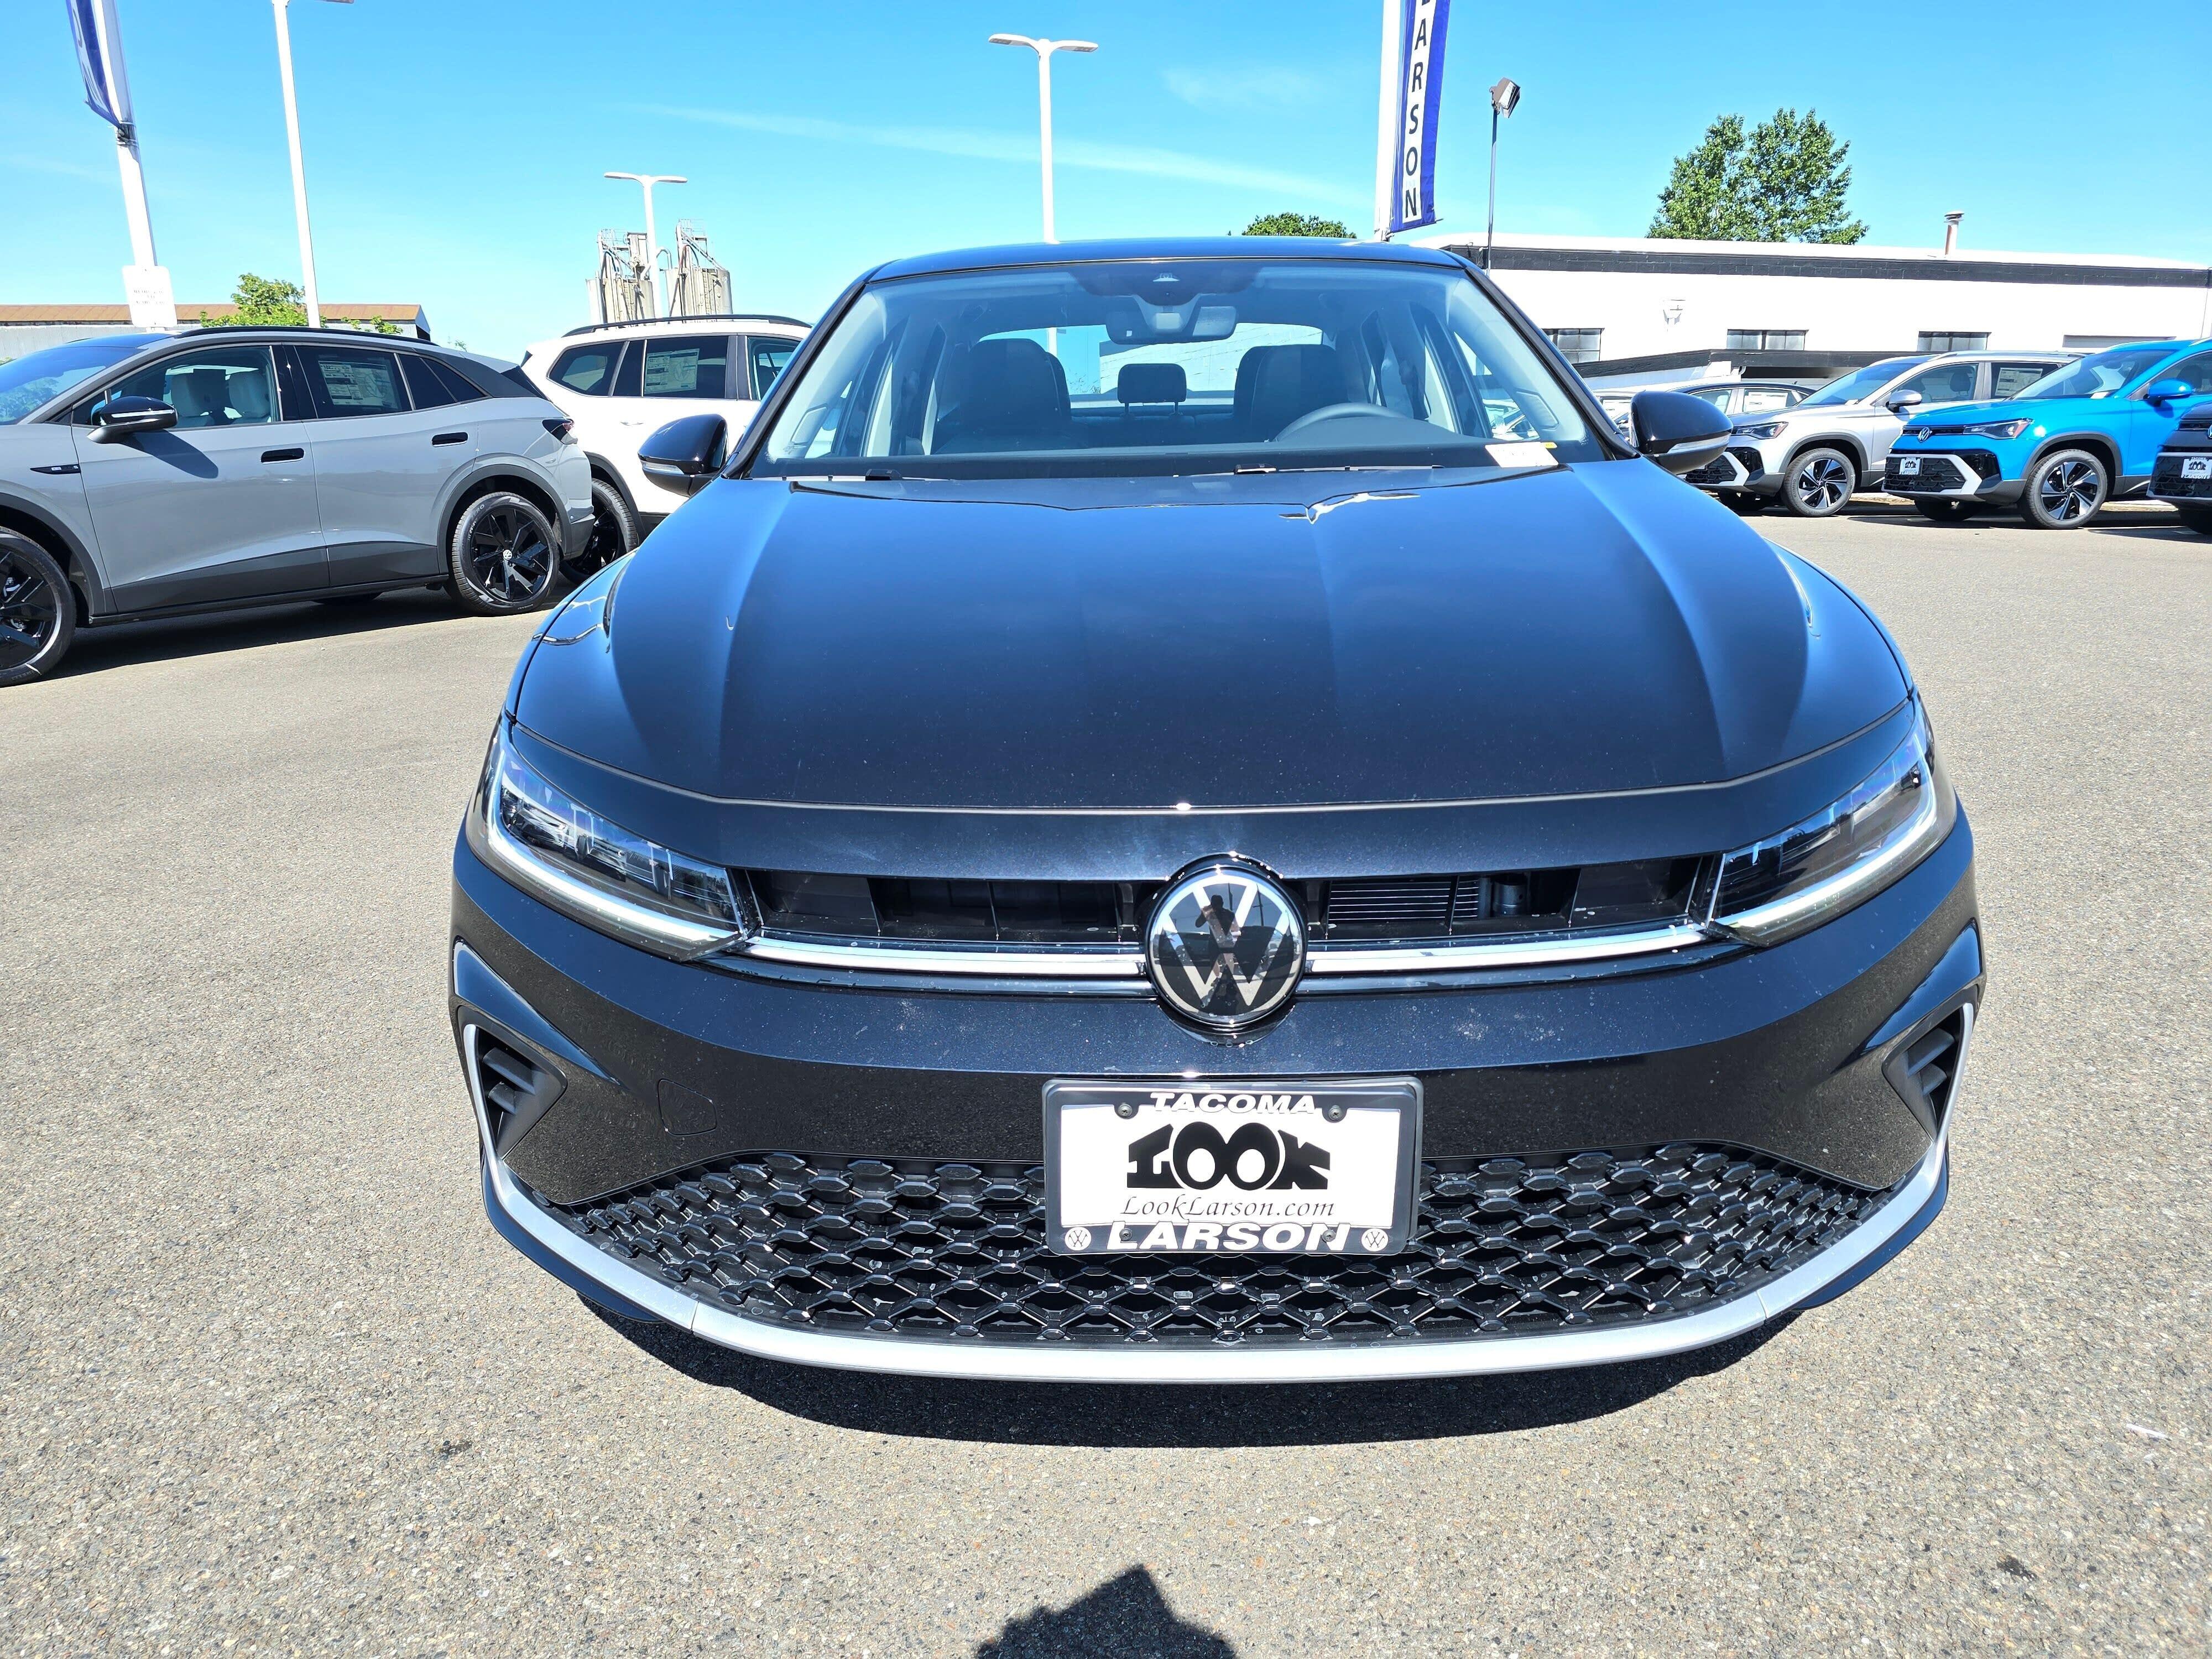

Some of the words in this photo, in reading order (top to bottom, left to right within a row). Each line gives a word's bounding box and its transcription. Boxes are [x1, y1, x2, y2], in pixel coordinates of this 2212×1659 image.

[1405, 0, 1430, 218] ARSON
[1150, 1092, 1316, 1114] TACOMA
[1127, 1121, 1331, 1191] LOOK
[1120, 1194, 1334, 1220] LookLarson.com
[1107, 1220, 1351, 1251] LARSON
